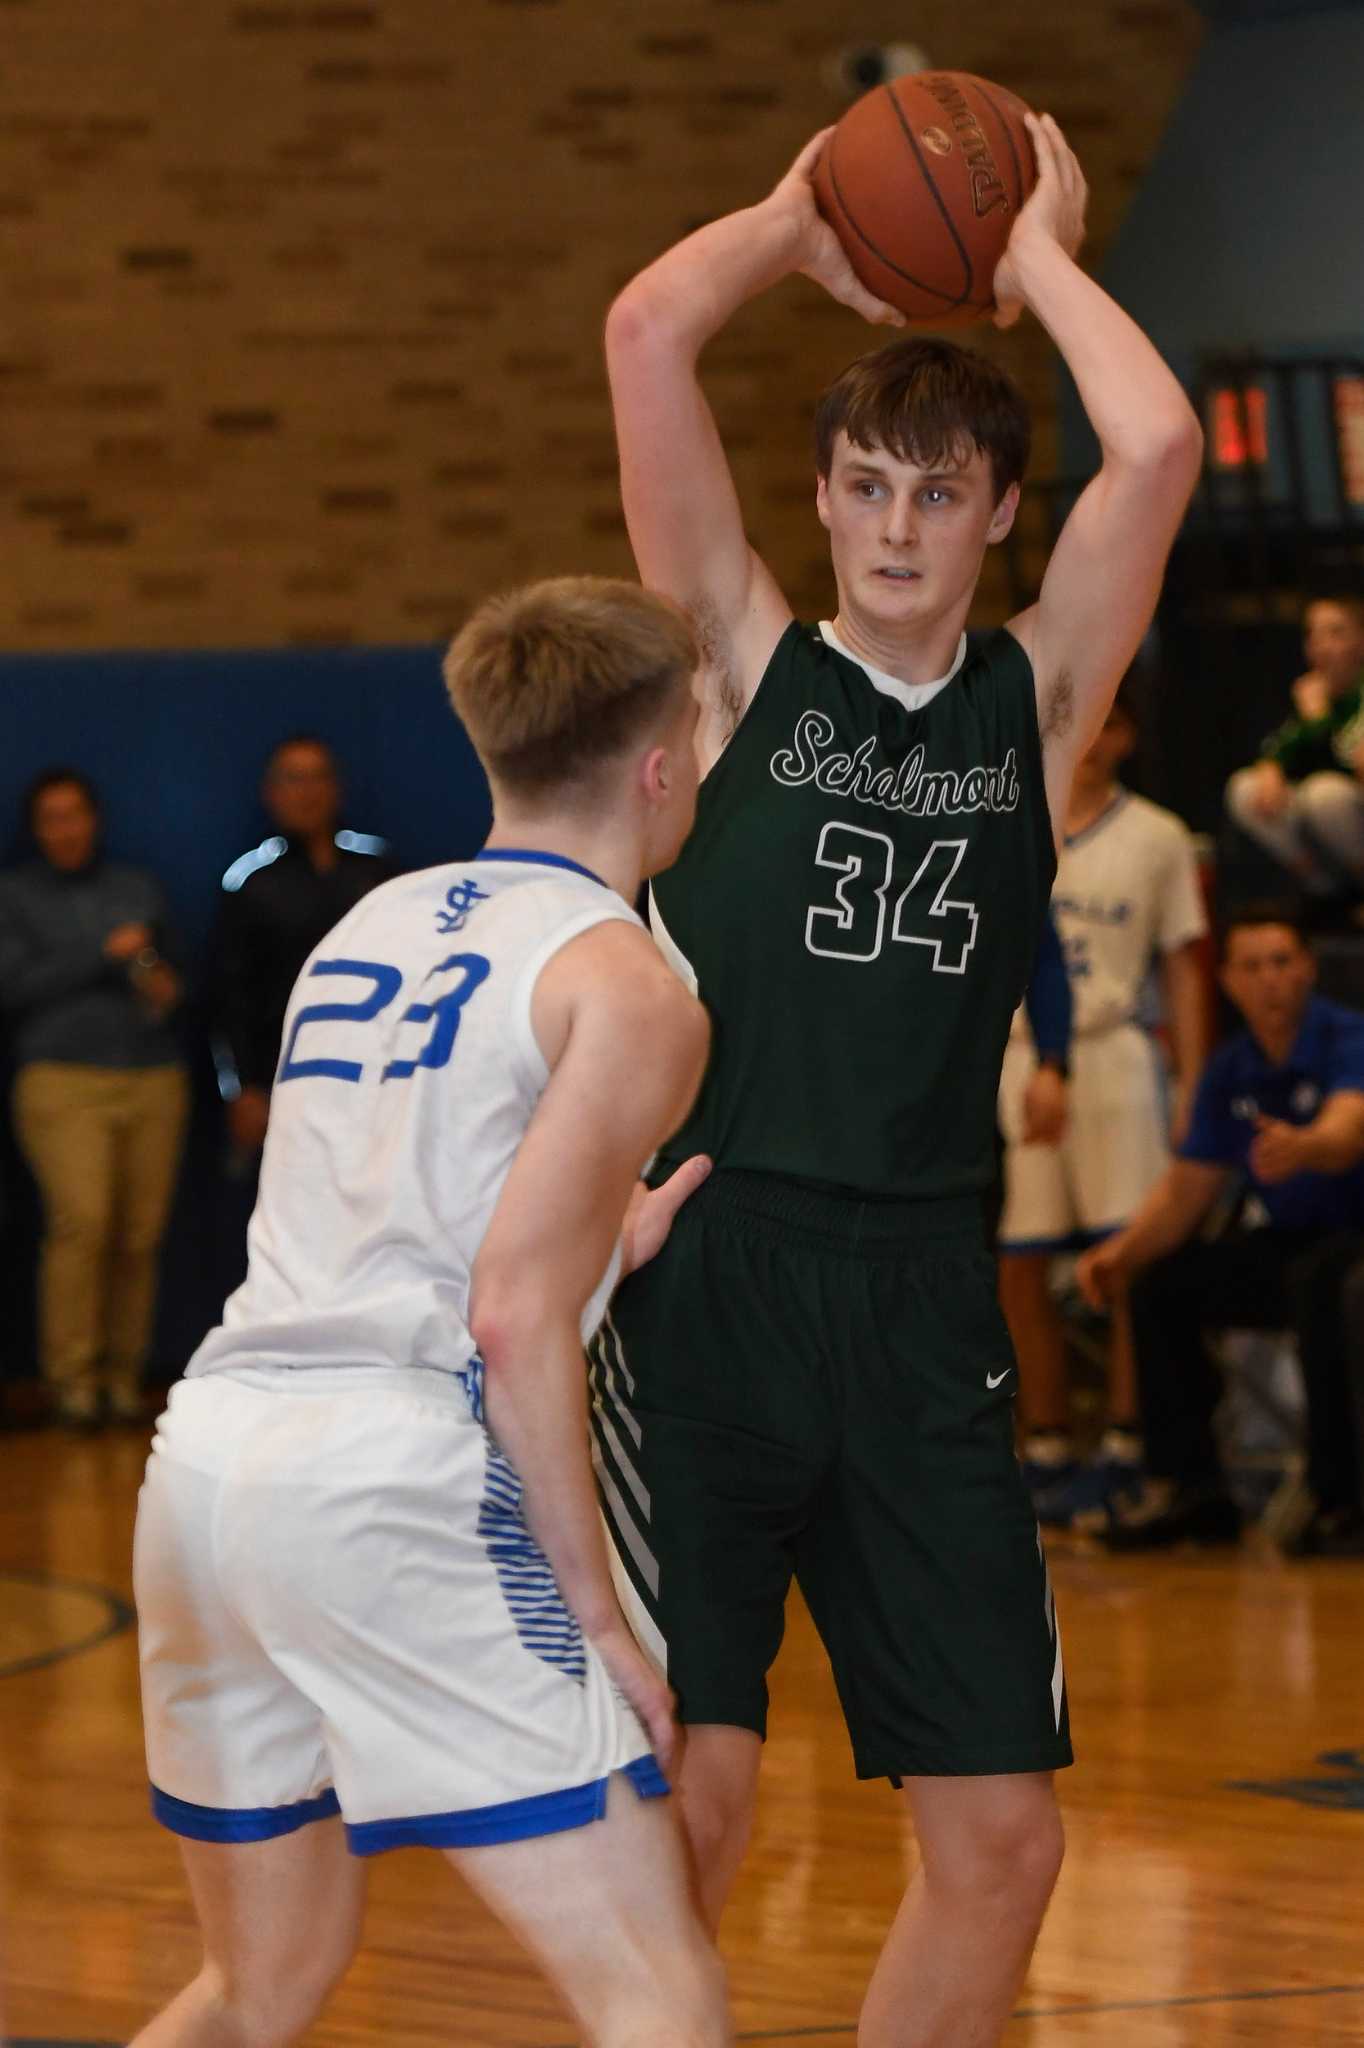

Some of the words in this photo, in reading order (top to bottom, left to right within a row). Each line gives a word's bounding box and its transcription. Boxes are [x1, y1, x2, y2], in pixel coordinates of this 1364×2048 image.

[769, 710, 1019, 817] Schalmont
[804, 820, 979, 975] 34
[277, 952, 491, 1084] 23
